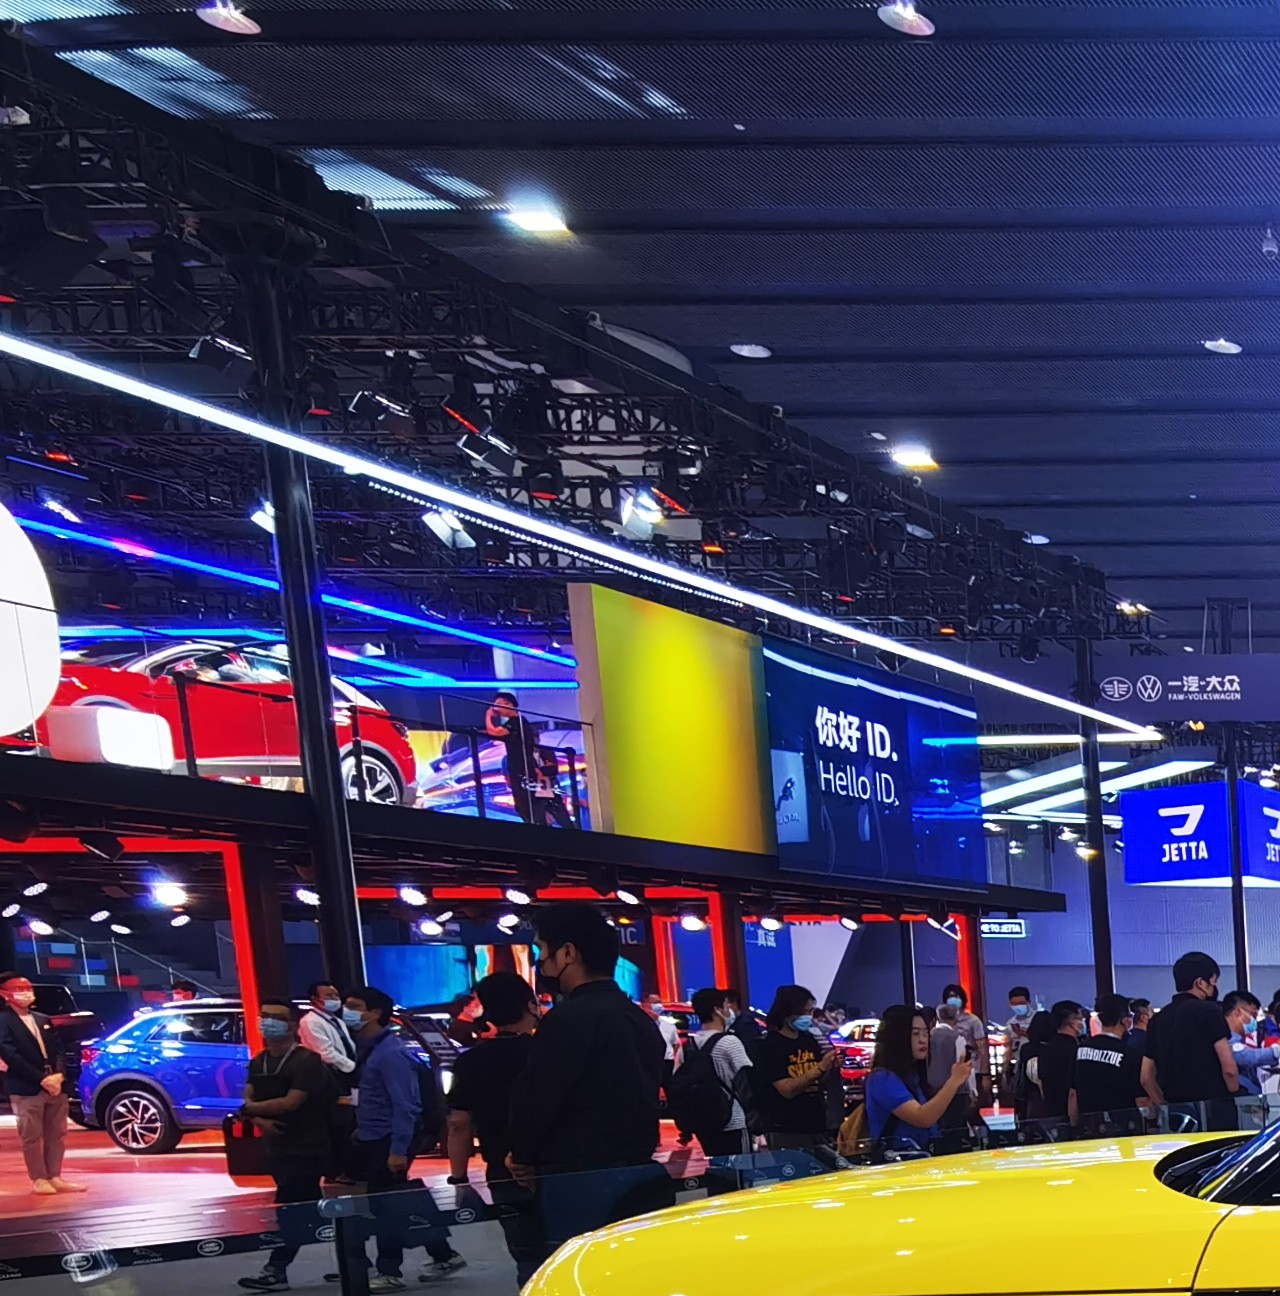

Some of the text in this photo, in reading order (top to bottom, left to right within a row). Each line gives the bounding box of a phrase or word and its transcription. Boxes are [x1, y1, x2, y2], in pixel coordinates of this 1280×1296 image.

[1168, 693, 1241, 701] FAW-VOLKSWAGEN
[815, 705, 898, 762] 你好 ID.
[819, 760, 870, 800] Hello
[1162, 840, 1209, 863] JETTA
